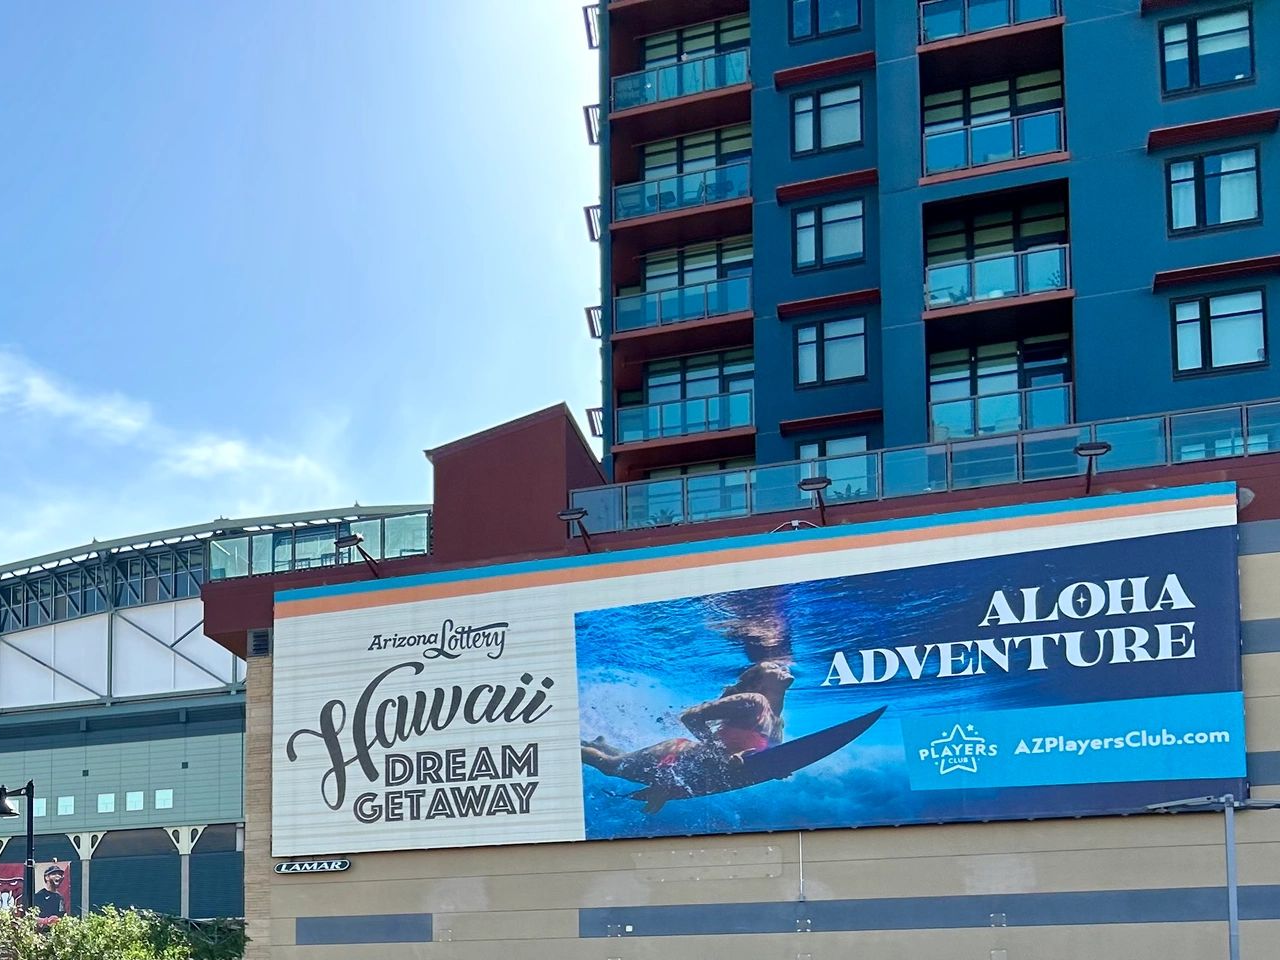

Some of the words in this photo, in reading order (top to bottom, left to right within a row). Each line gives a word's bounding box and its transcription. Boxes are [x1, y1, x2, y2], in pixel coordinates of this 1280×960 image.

[978, 573, 1196, 627] ALOHA
[367, 633, 439, 651] Arizona
[423, 618, 509, 659] Lottery
[821, 621, 1196, 687] ADVENTURE
[286, 661, 555, 811] Hawaii
[918, 743, 998, 761] PLAYERS
[1013, 727, 1231, 756] AZPlayersClub.com
[384, 743, 539, 787] DREAM
[353, 781, 540, 824] GETAWAY
[280, 861, 342, 872] LAMAR
